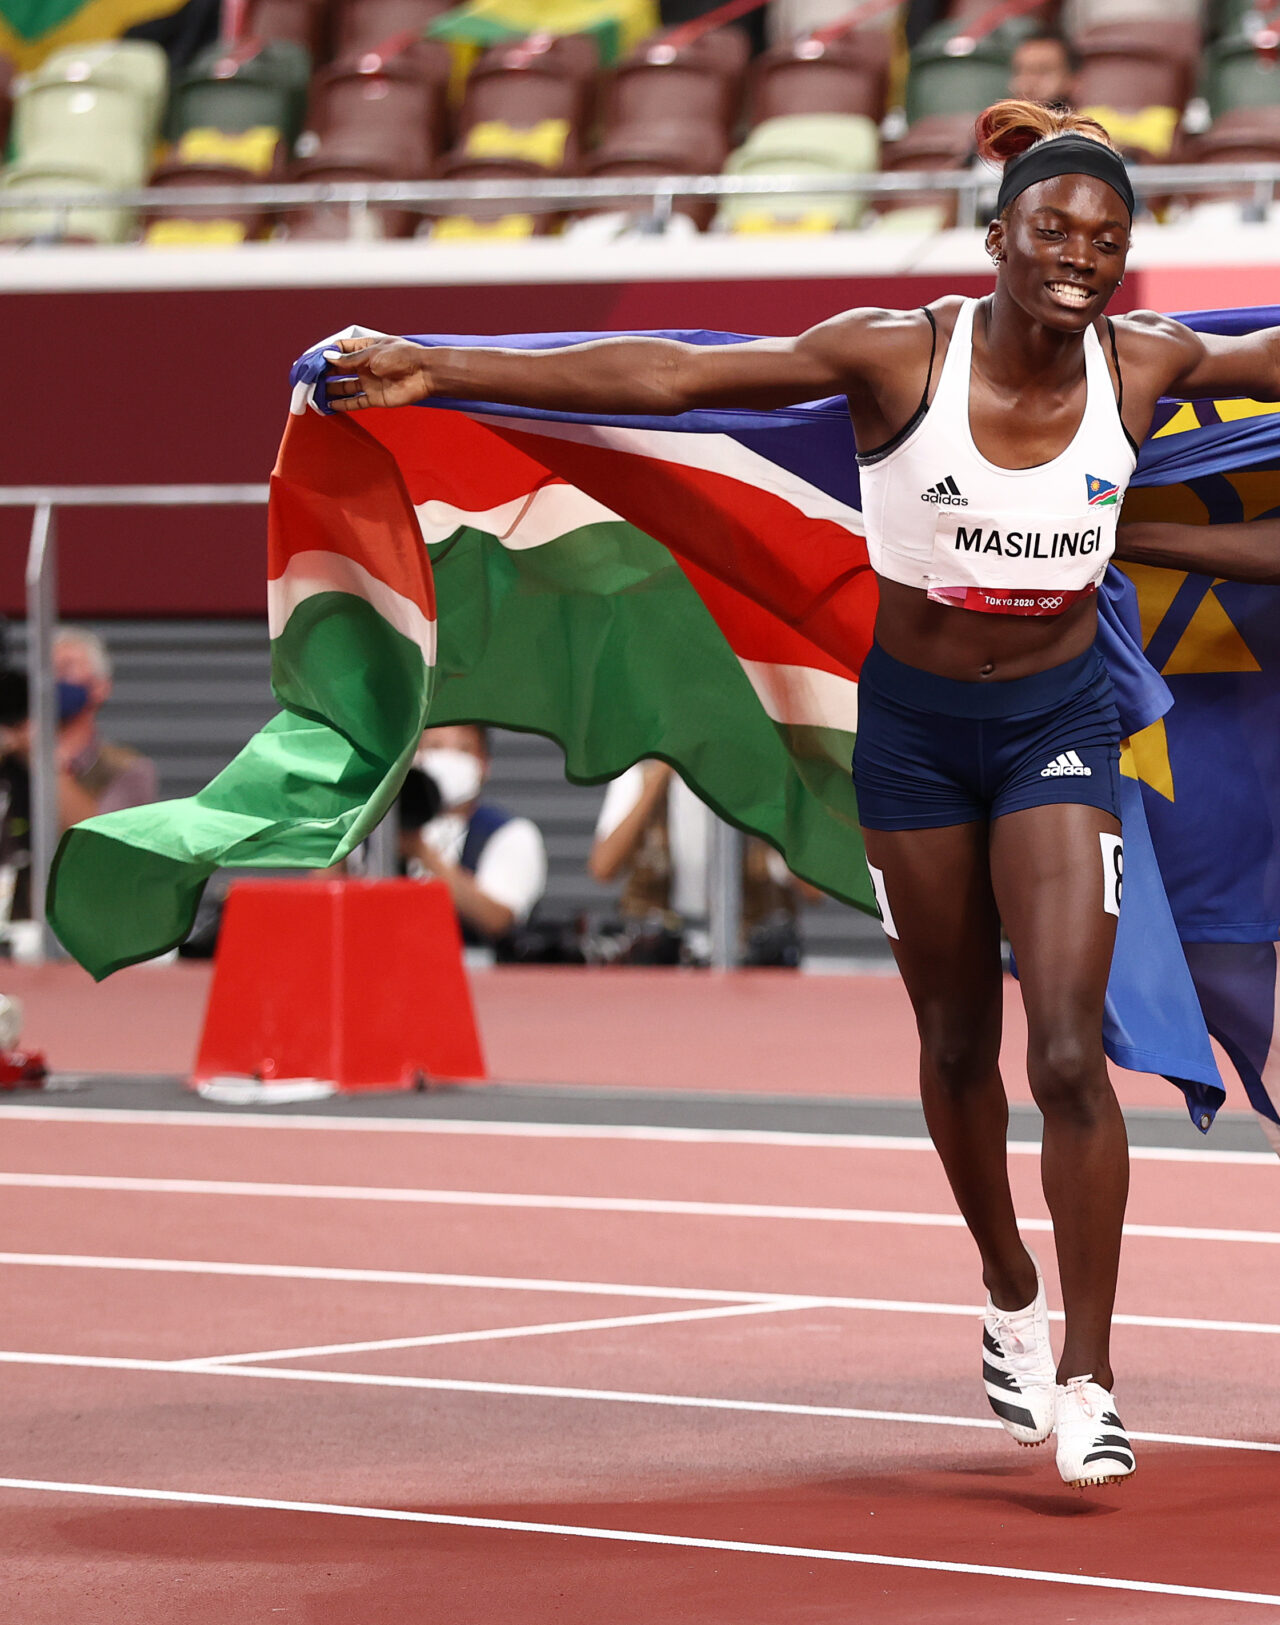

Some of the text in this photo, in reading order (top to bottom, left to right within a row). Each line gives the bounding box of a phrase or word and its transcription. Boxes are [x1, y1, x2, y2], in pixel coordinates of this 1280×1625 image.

[921, 491, 969, 507] adidas
[954, 526, 1102, 559] MASILINGI
[984, 595, 1035, 607] TOKYO 2020
[1040, 764, 1092, 777] adidas
